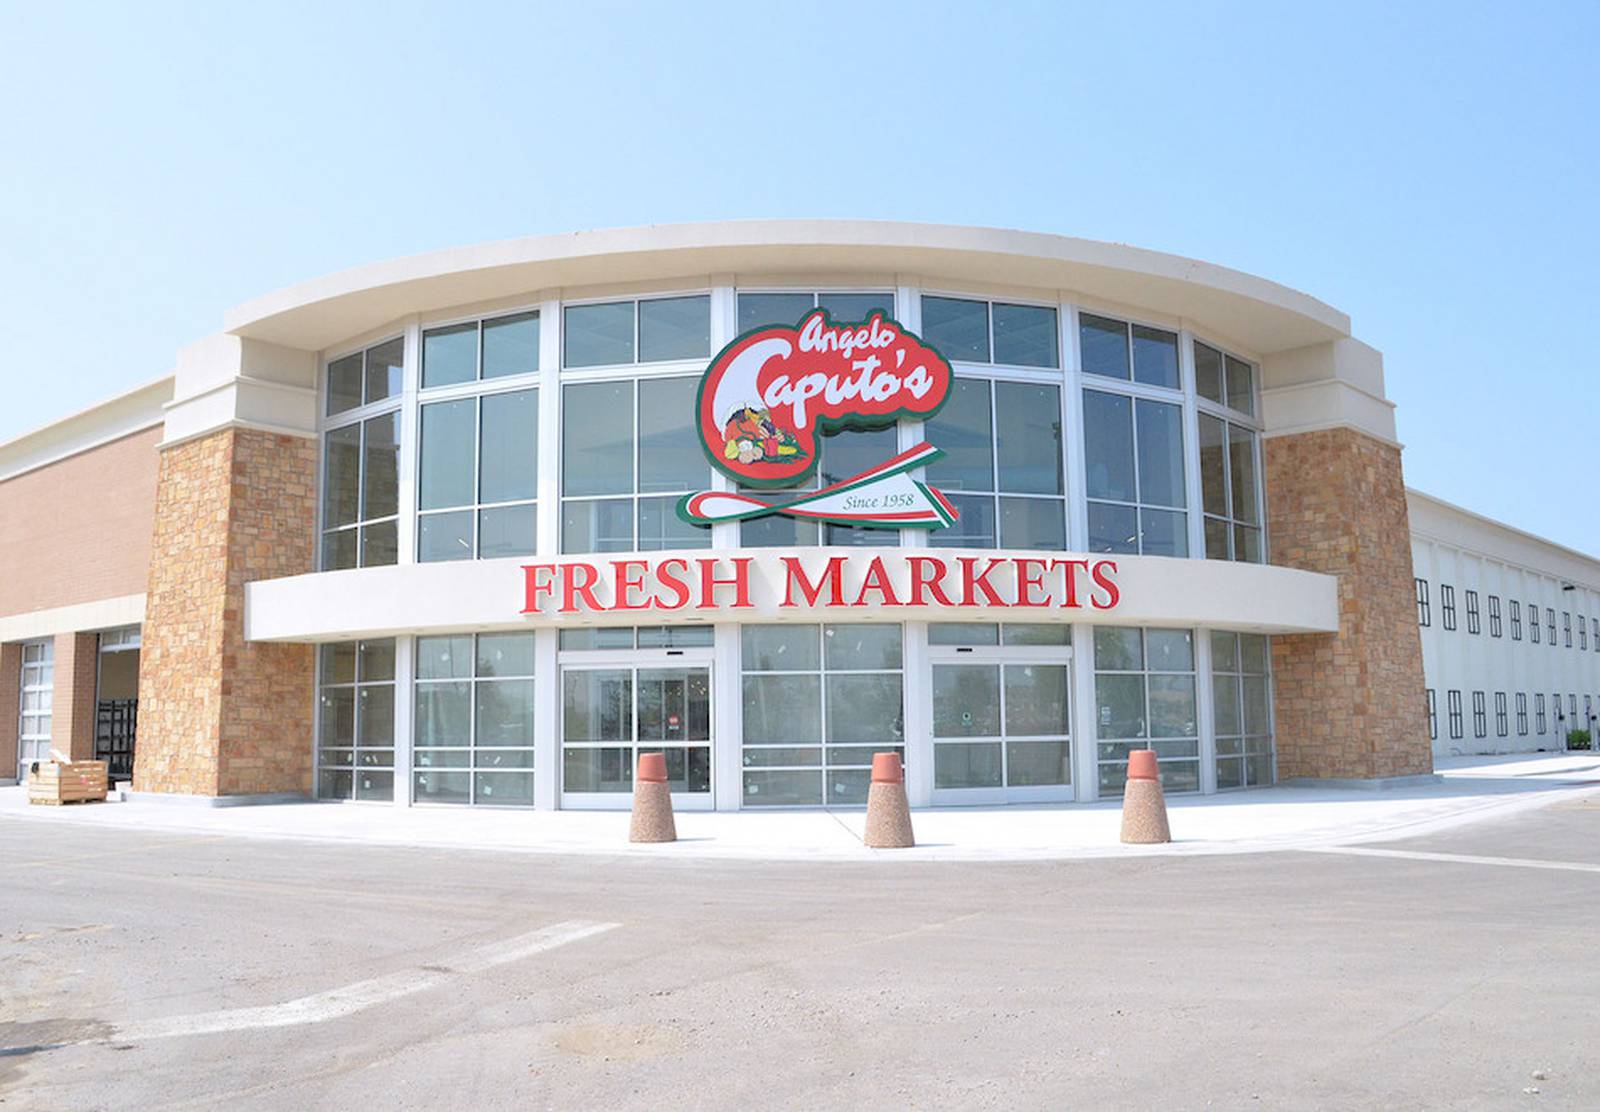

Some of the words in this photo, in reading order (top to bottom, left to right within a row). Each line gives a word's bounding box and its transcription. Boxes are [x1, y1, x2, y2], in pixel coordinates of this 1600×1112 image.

[799, 315, 895, 358] Angelo
[712, 338, 933, 442] Caputo's
[843, 496, 878, 510] Since
[882, 494, 914, 507] 1958
[520, 557, 754, 613] FRESH
[779, 555, 1120, 609] MARKETS
